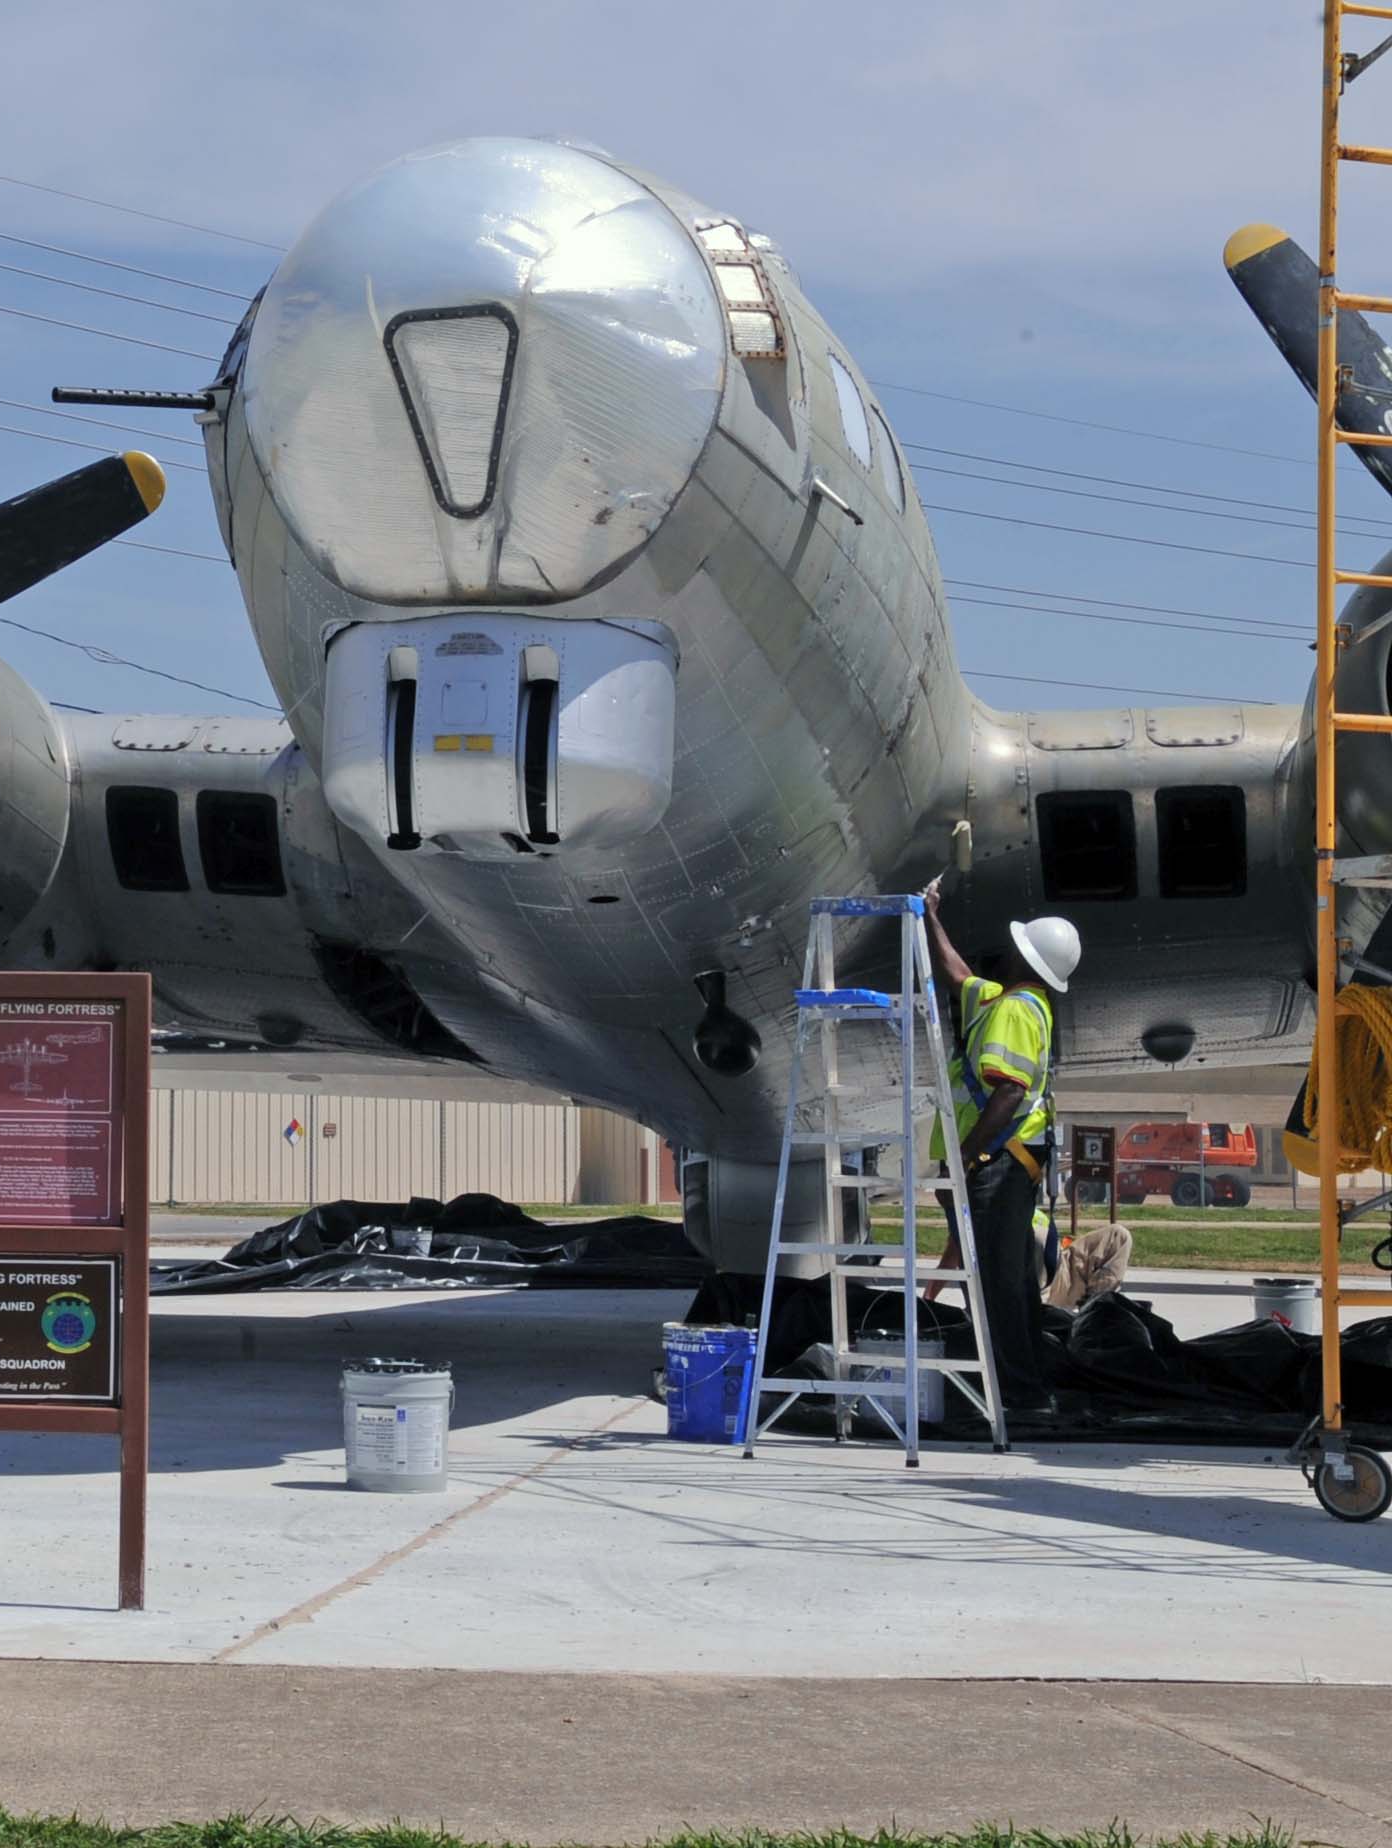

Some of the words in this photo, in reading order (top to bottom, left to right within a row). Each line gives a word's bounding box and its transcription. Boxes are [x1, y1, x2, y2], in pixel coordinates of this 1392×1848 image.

[47, 1004, 121, 1016] FORTRESS"
[8, 1273, 83, 1285] FORTRESS"
[0, 1359, 66, 1370] SQUADRON
[28, 1382, 42, 1390] the
